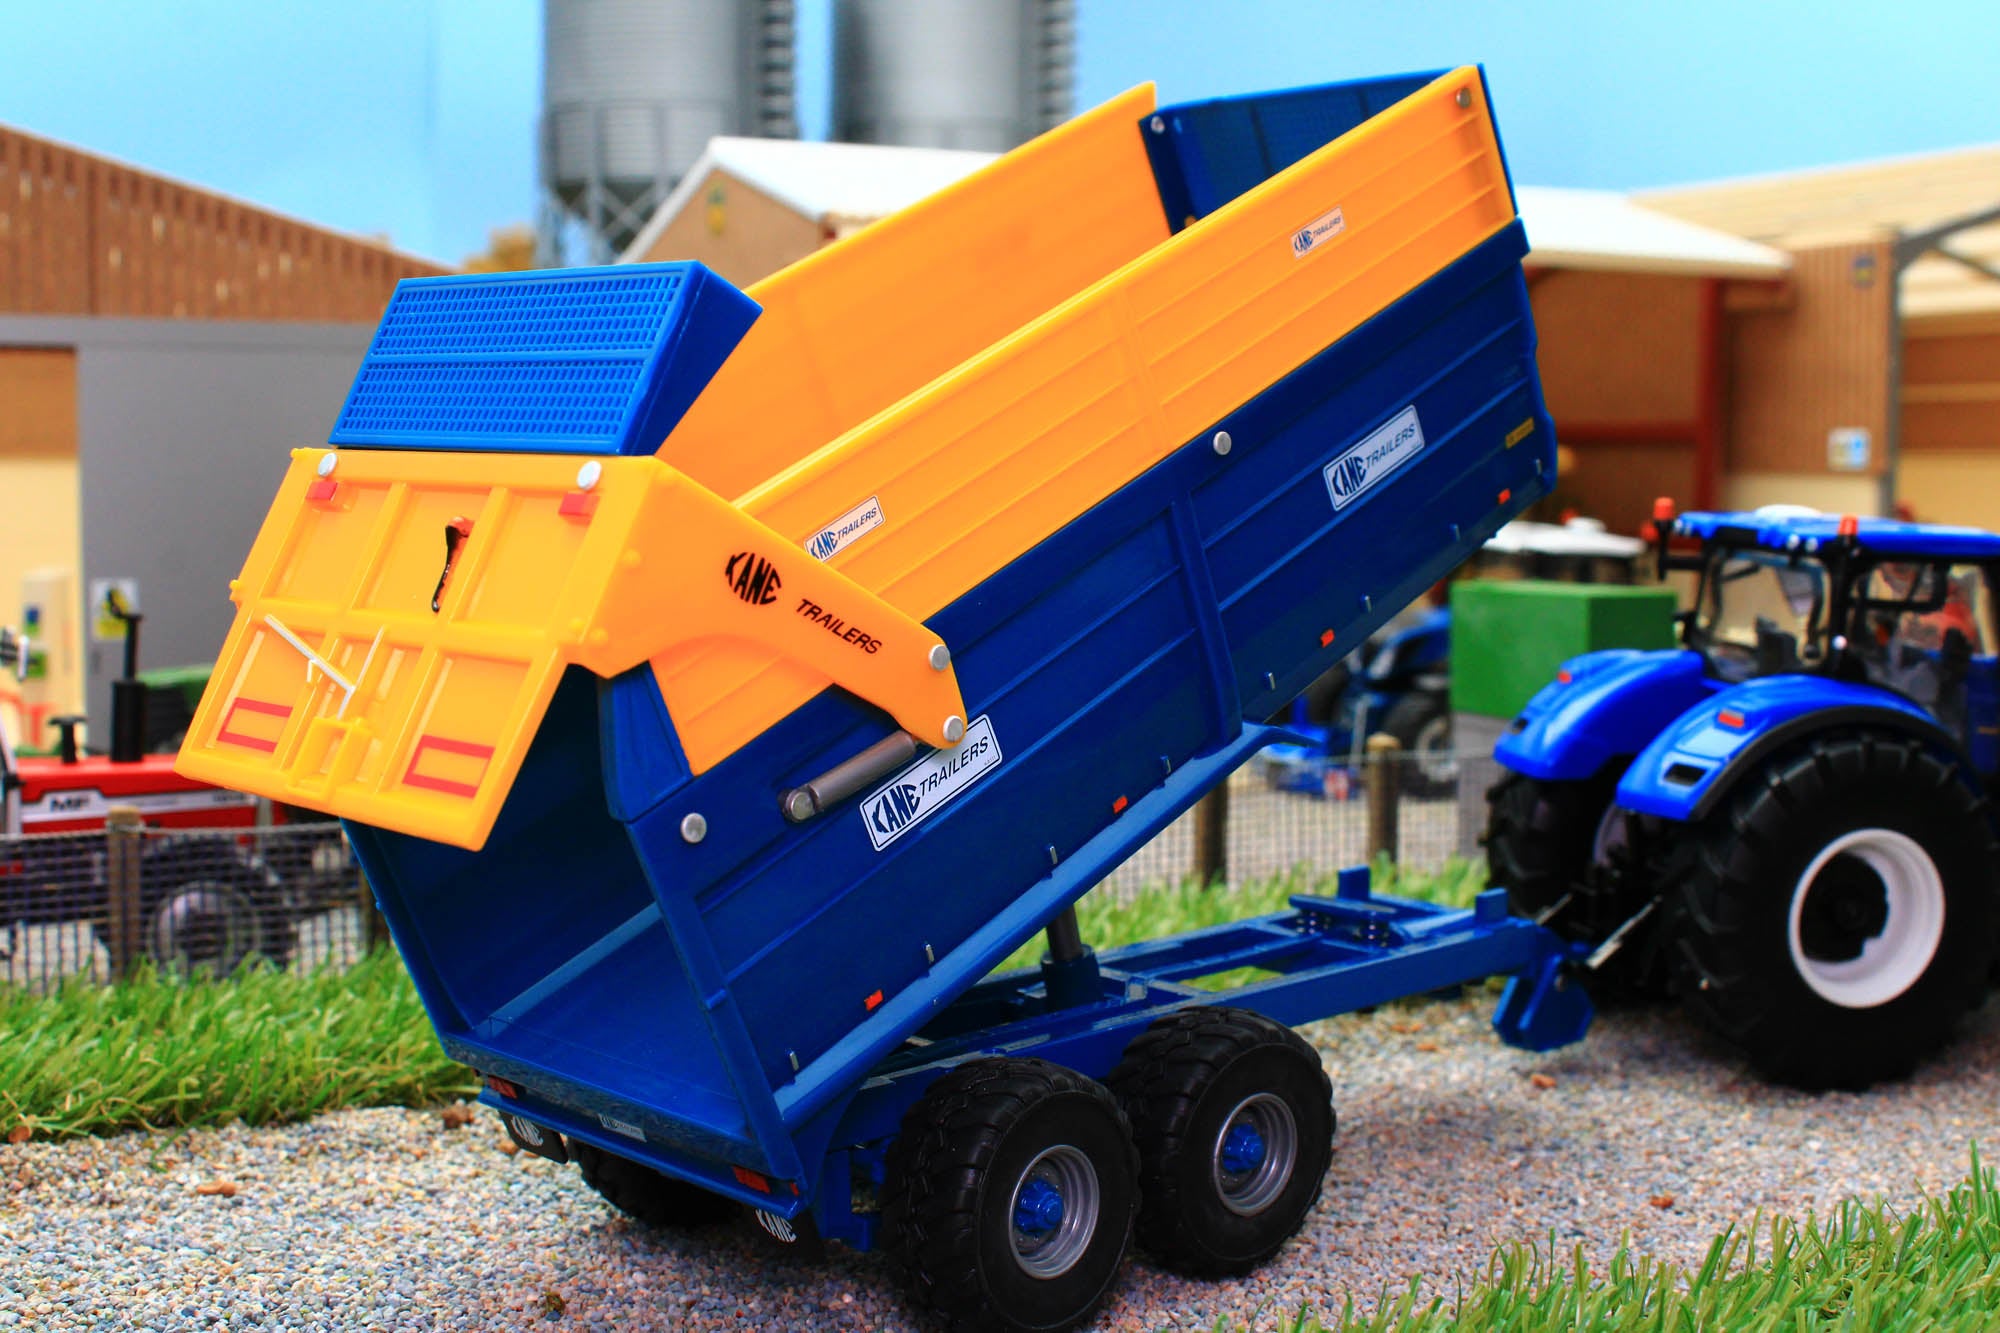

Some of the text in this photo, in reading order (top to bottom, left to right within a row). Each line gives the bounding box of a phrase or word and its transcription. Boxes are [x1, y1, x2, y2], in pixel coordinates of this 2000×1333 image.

[1294, 229, 1314, 253] KANE
[1332, 423, 1415, 497] KANE TRAILERS
[810, 507, 877, 560] KANE TRAILERS
[725, 552, 882, 654] KANE TRAILERS
[872, 736, 989, 834] KANE TRAILERS
[511, 1116, 544, 1147] KANE
[755, 1208, 797, 1243] KANE
